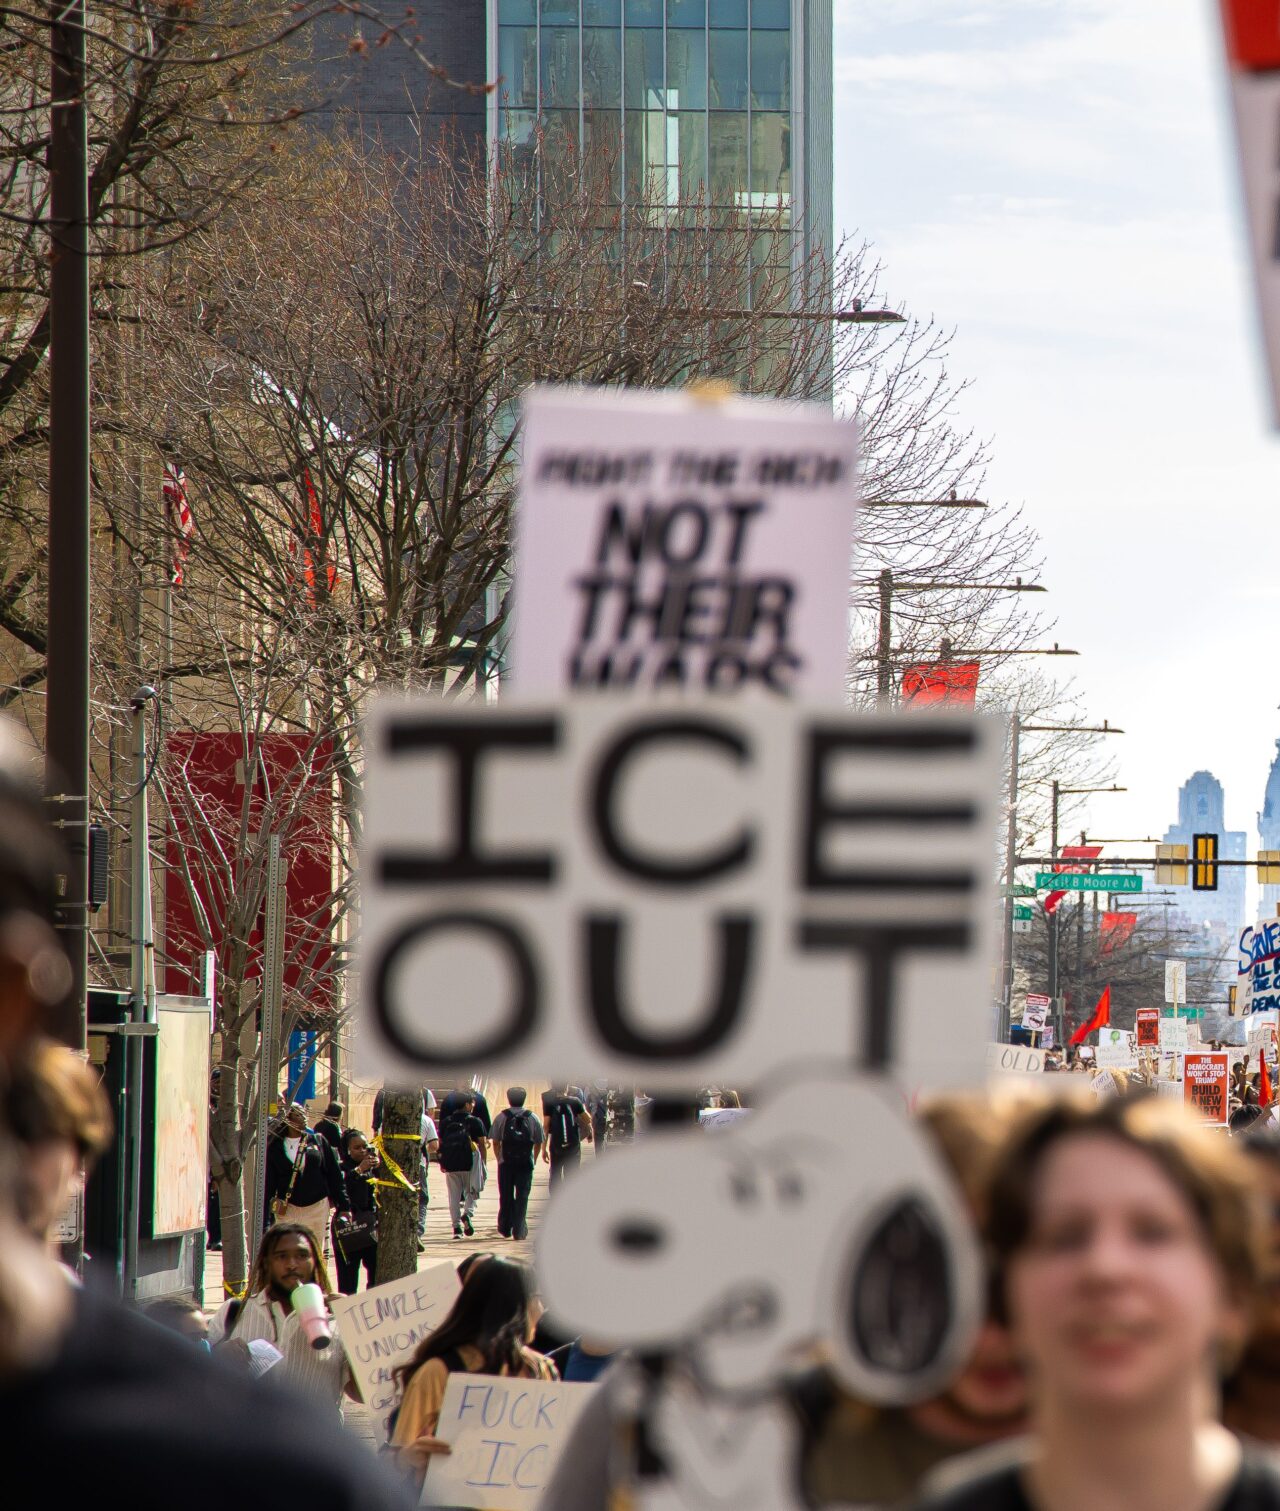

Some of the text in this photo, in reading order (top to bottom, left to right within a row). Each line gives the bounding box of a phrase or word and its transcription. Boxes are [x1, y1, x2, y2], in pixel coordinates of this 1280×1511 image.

[596, 500, 767, 567] NOT
[571, 577, 797, 643] THEIR
[376, 712, 979, 888] ICE
[1073, 877, 1079, 887] B
[1083, 877, 1119, 888] Moore
[1123, 878, 1137, 888] Av
[371, 906, 976, 1074] OUT
[1192, 1085, 1221, 1096] BUILD
[1200, 1096, 1222, 1106] NEW
[344, 1285, 436, 1335] TEMPLE
[458, 1385, 558, 1429] FUCK
